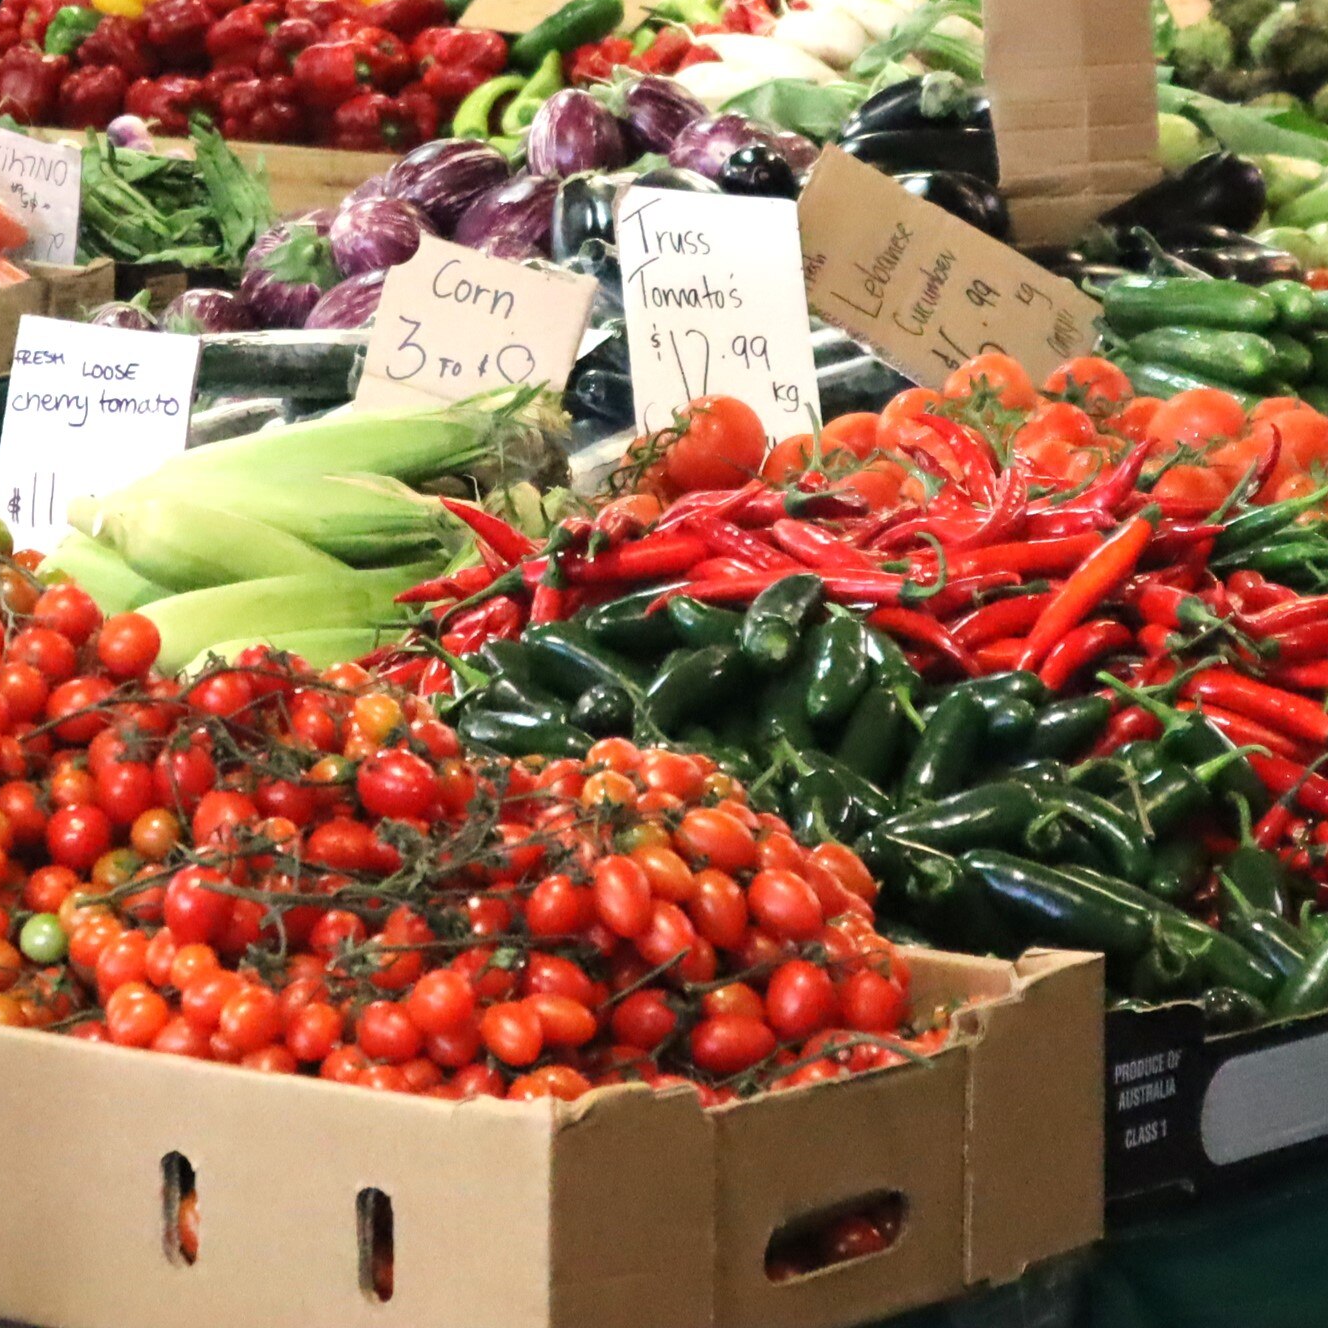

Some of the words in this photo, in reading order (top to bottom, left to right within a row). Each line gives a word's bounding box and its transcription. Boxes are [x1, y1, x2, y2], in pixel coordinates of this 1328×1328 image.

[622, 198, 711, 255] Truss
[628, 256, 743, 310] Tomato's
[830, 222, 914, 319] Lebanese
[432, 259, 515, 320] Corn
[14, 349, 66, 365] FRESH
[385, 315, 427, 381] 3
[82, 361, 140, 381] LOOSE
[99, 388, 180, 417] tomato
[1114, 1053, 1165, 1084] PRODUCE
[1167, 1048, 1183, 1070] OF
[1118, 1076, 1177, 1112] AUSTRALIA
[1124, 1119, 1159, 1150] CLASS
[1160, 1118, 1168, 1138] 1
